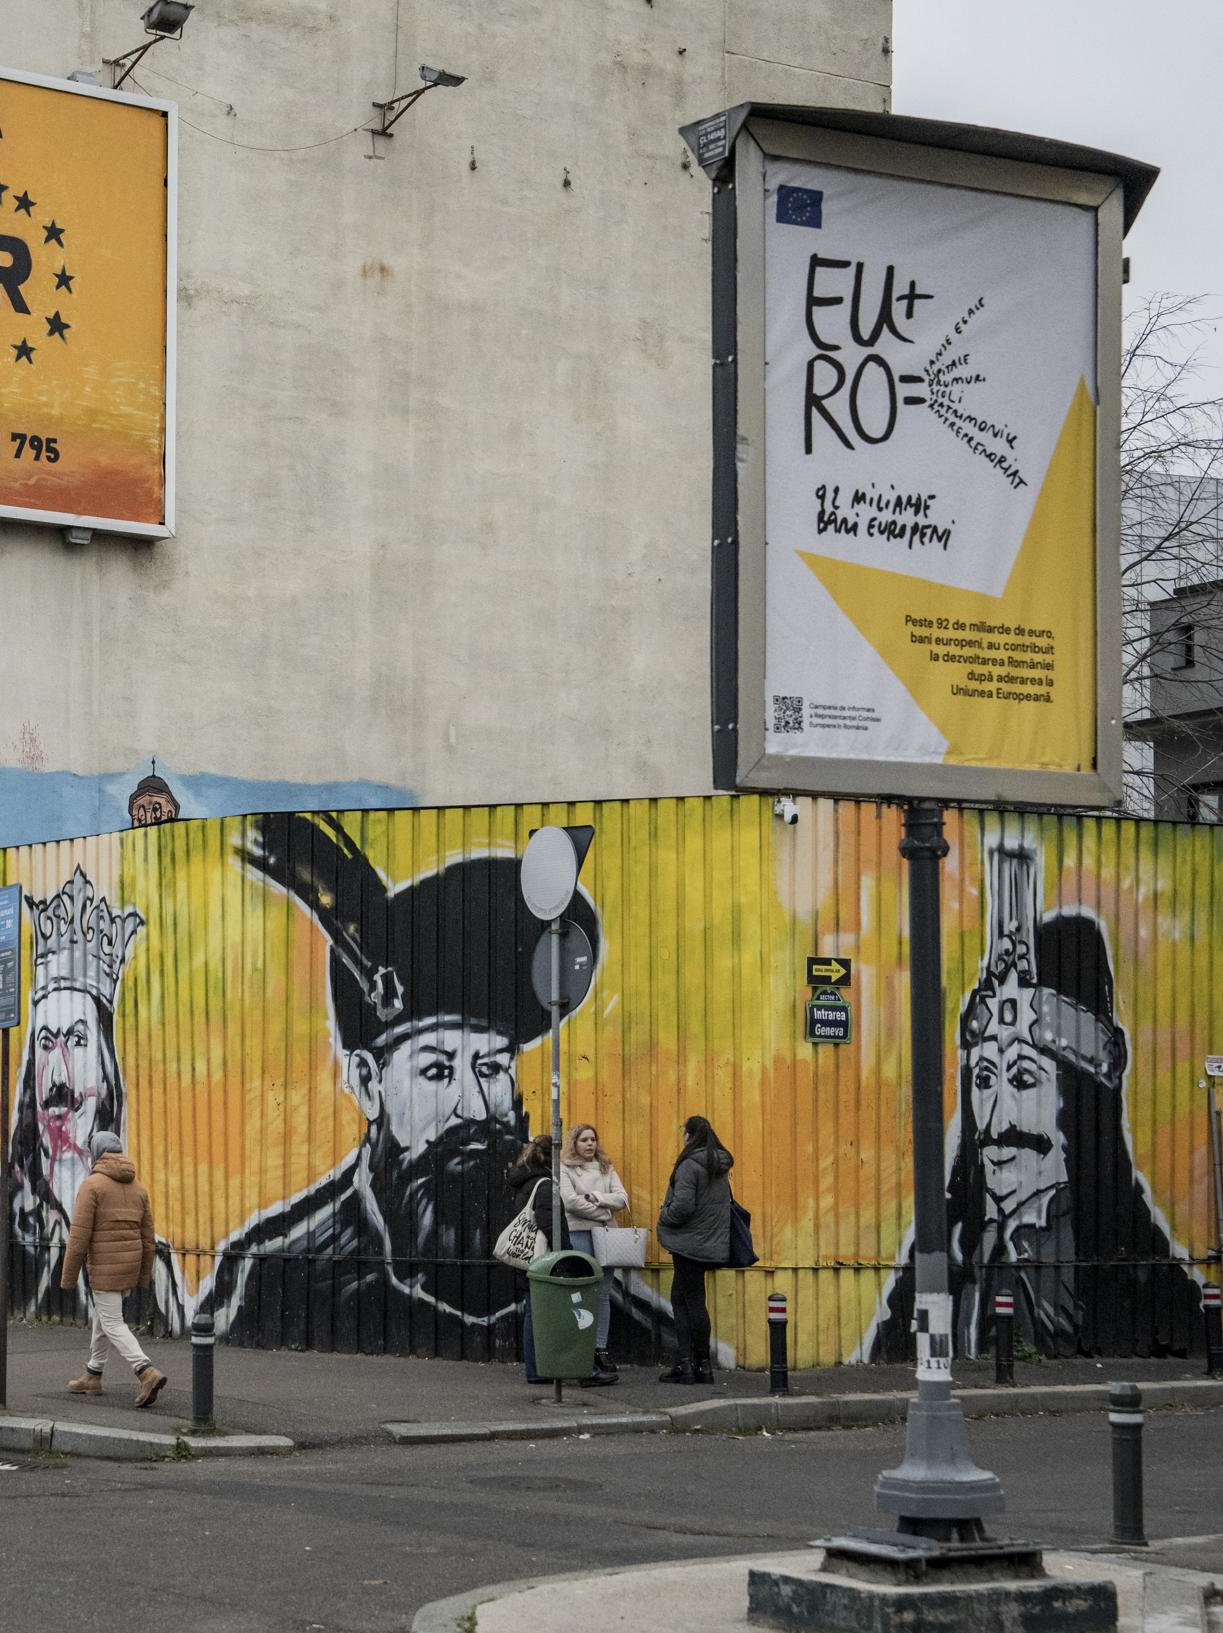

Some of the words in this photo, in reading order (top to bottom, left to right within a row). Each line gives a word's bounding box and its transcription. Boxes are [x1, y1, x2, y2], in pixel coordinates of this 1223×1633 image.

[954, 297, 985, 334] EGALE
[11, 432, 60, 463] 795
[816, 484, 840, 510] 92
[851, 482, 936, 518] MILIARDE
[867, 517, 955, 551] EUROPENI
[905, 615, 934, 628] Peste
[936, 618, 950, 630] 92
[952, 619, 967, 631] de
[969, 621, 1012, 635] miliarde
[1014, 625, 1026, 637] de
[1027, 629, 1055, 640] euro,
[910, 632, 933, 645] bani
[935, 637, 985, 651] europeni,
[987, 641, 1001, 650] au
[1003, 641, 1055, 655] contribuit
[930, 650, 940, 661] la
[942, 651, 1006, 667] dezvoltarea
[1007, 656, 1055, 671] României
[967, 670, 994, 684] după
[996, 673, 1043, 686] aderarea
[1045, 675, 1055, 687] la
[951, 684, 994, 699] Uniunea
[996, 688, 1054, 703] Europeană.
[814, 1008, 846, 1020] Intrarea
[815, 1023, 844, 1036] Geneva
